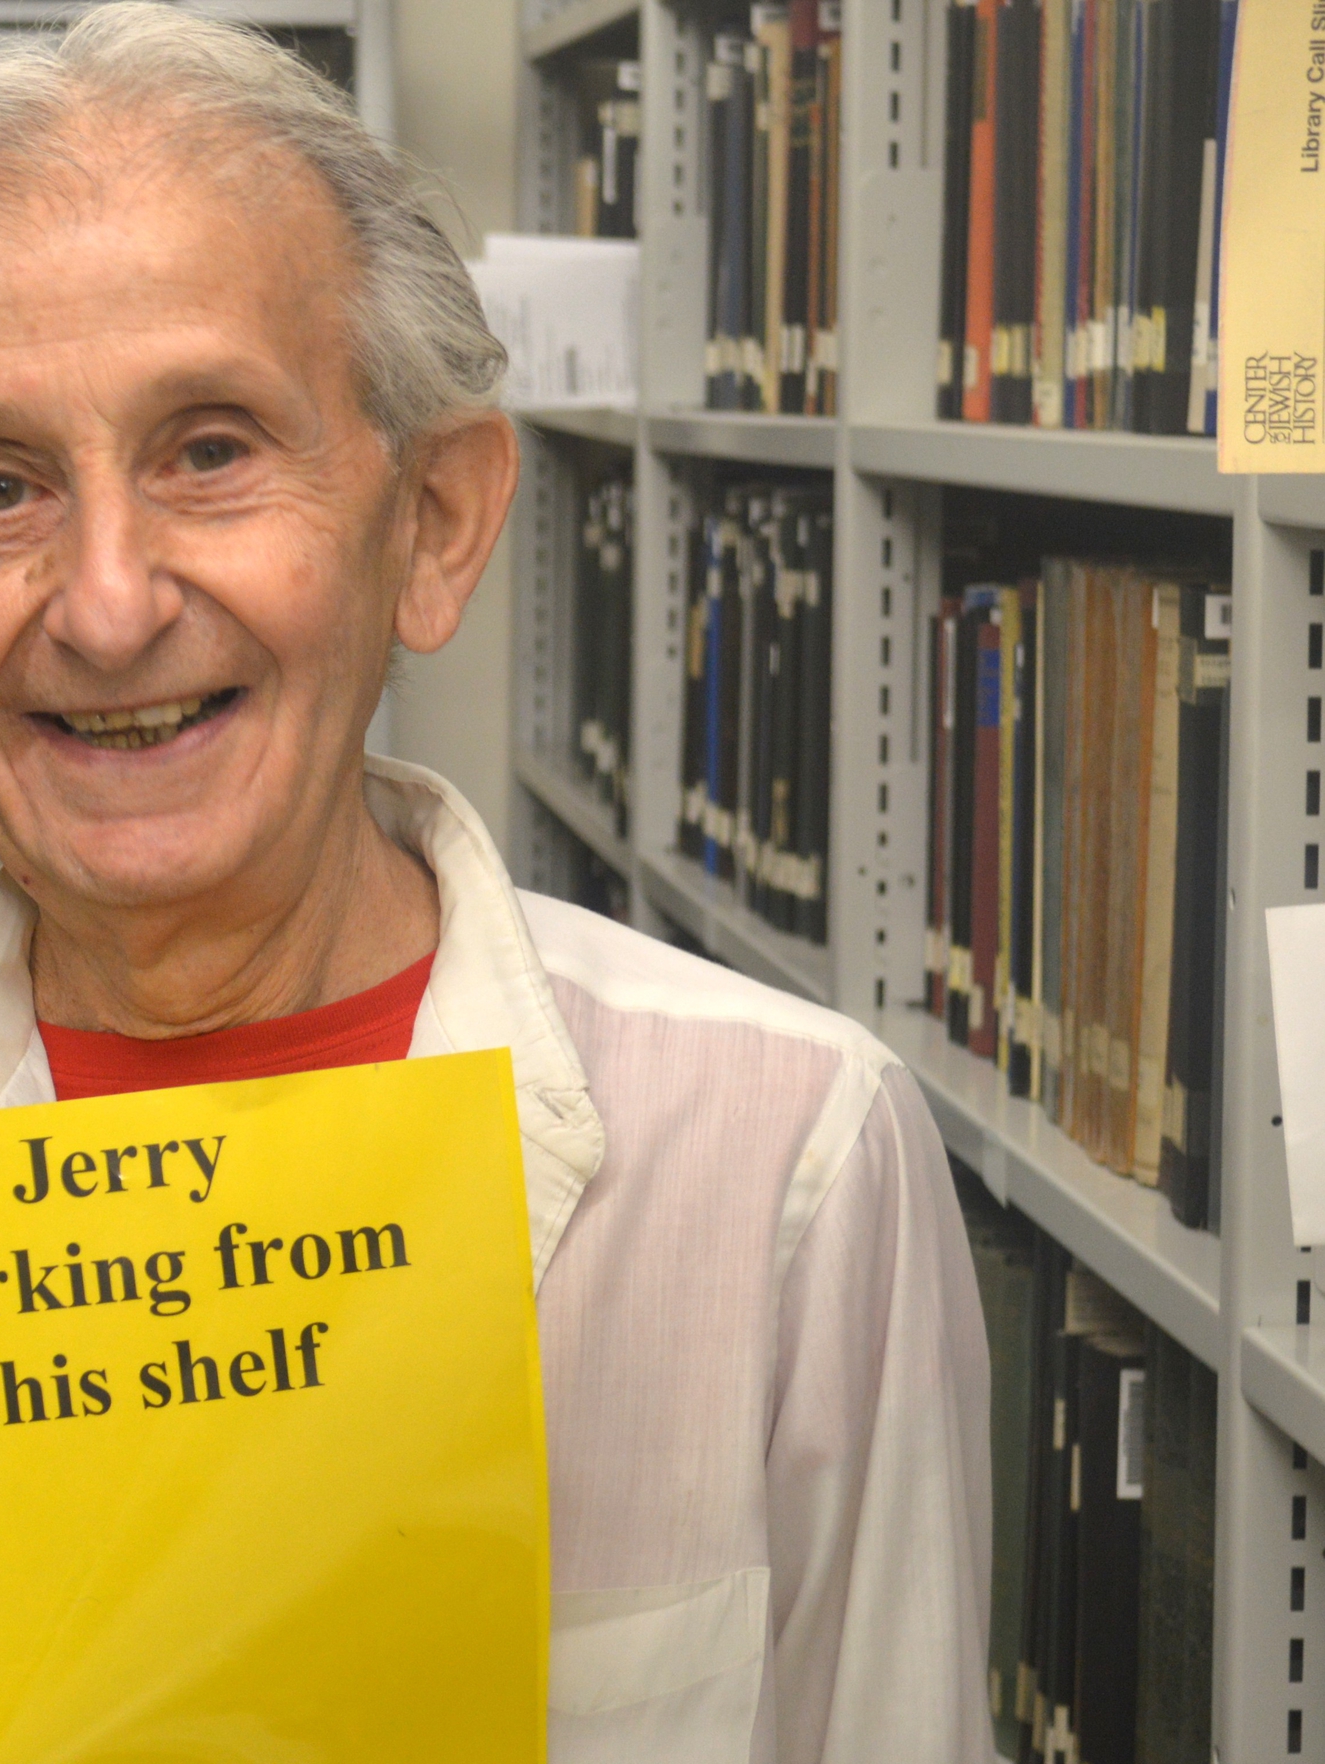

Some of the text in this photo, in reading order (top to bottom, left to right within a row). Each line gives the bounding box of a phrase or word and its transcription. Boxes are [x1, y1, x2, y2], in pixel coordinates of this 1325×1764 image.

[1301, 0, 1325, 173] Library Call Sli
[1243, 350, 1268, 444] CENTER
[1268, 356, 1293, 432] JEWISH
[1293, 350, 1317, 444] HISTORY
[13, 1134, 227, 1204] Jerry
[214, 1222, 412, 1292] from
[140, 1322, 330, 1410] shelf
